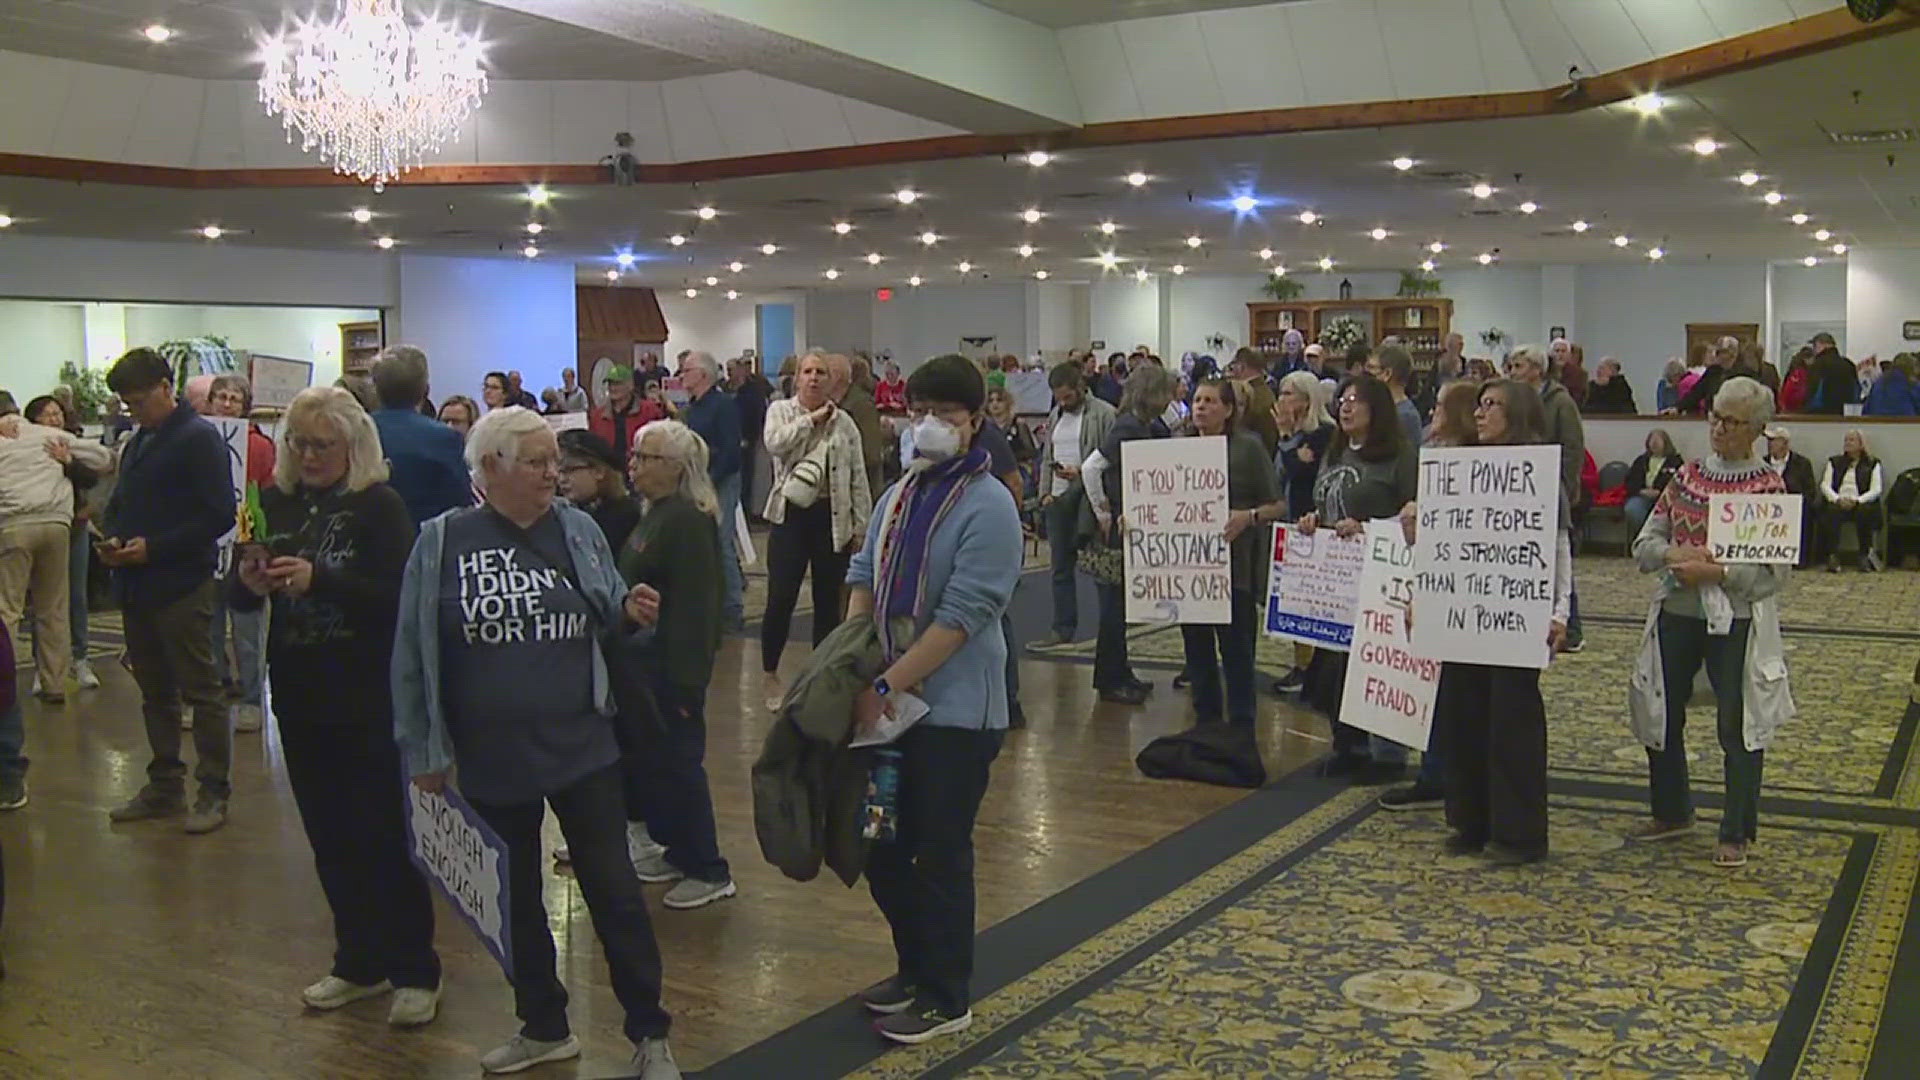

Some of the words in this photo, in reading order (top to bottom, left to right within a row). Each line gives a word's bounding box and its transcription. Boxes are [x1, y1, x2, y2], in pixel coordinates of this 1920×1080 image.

[1132, 469, 1144, 493] IF
[1147, 468, 1174, 491] YOU
[1421, 460, 1460, 496] THE
[1471, 459, 1536, 496] POWER
[1132, 504, 1158, 525] THE
[1446, 508, 1474, 530] THE
[1734, 524, 1757, 541] UP
[1763, 521, 1789, 539] FOR
[458, 548, 518, 577] HEY,
[1129, 528, 1228, 568] RESISTANCE
[1372, 536, 1416, 567] ELO
[1434, 541, 1451, 561] IS
[1460, 541, 1547, 570] STRONGER
[1714, 544, 1798, 560] DEMOCRACY
[460, 578, 468, 597] I
[1132, 574, 1185, 600] SPILLS
[1191, 574, 1231, 600] OVER
[1389, 576, 1415, 605] IS
[1416, 572, 1455, 594] THAN
[1465, 573, 1492, 596] THE
[1498, 573, 1551, 600] PEOPLE
[460, 591, 545, 622] VOTE
[1447, 606, 1466, 630] IN
[1472, 604, 1527, 634] POWER
[463, 618, 525, 644] FOR
[535, 613, 587, 641] HIM
[1363, 610, 1394, 635] THE
[1360, 641, 1441, 682] GOVERNMENT
[422, 834, 484, 919] ENOUGH
